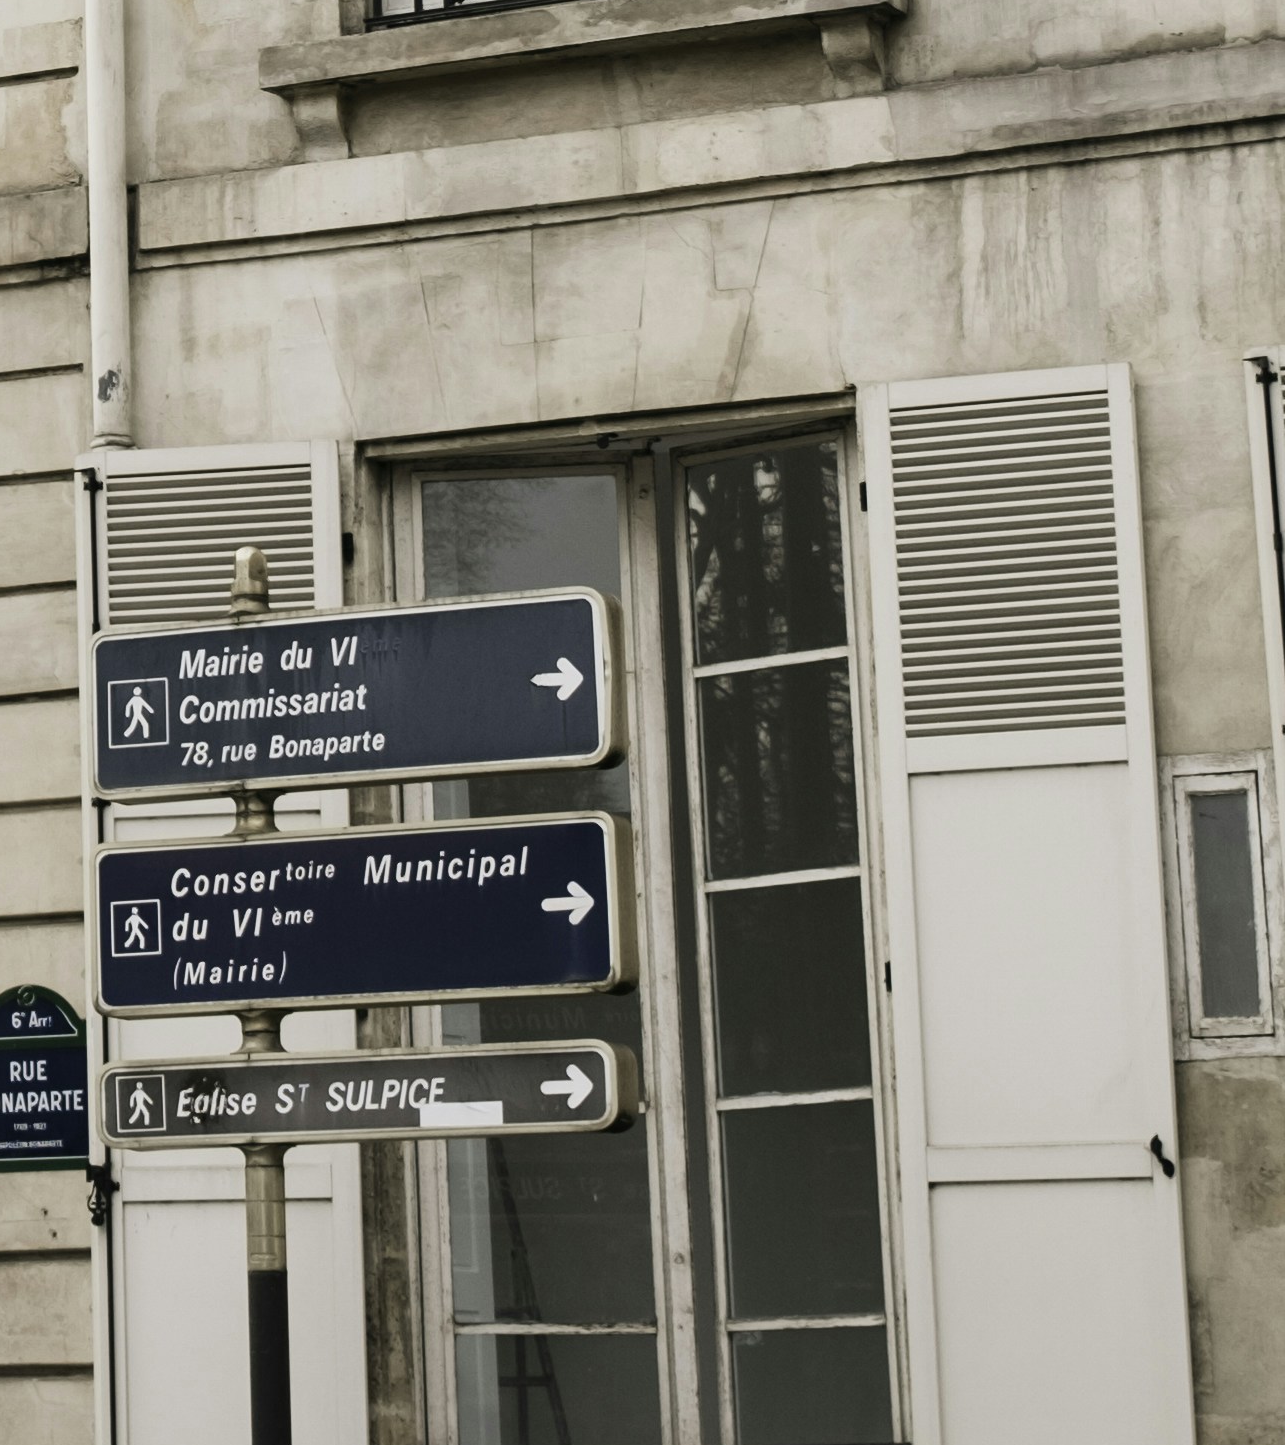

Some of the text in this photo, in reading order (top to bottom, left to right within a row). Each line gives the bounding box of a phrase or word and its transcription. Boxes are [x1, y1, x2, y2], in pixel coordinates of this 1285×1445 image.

[179, 645, 264, 679] Mairie
[280, 640, 313, 671] du
[179, 683, 368, 724] Commissariat
[180, 730, 386, 768] 78, rue Bonaparte
[363, 845, 529, 886] Municipal
[172, 912, 209, 941] du
[173, 951, 287, 990] (Mairie)
[10, 1059, 48, 1082] RUE
[325, 1077, 446, 1113] SULPICE
